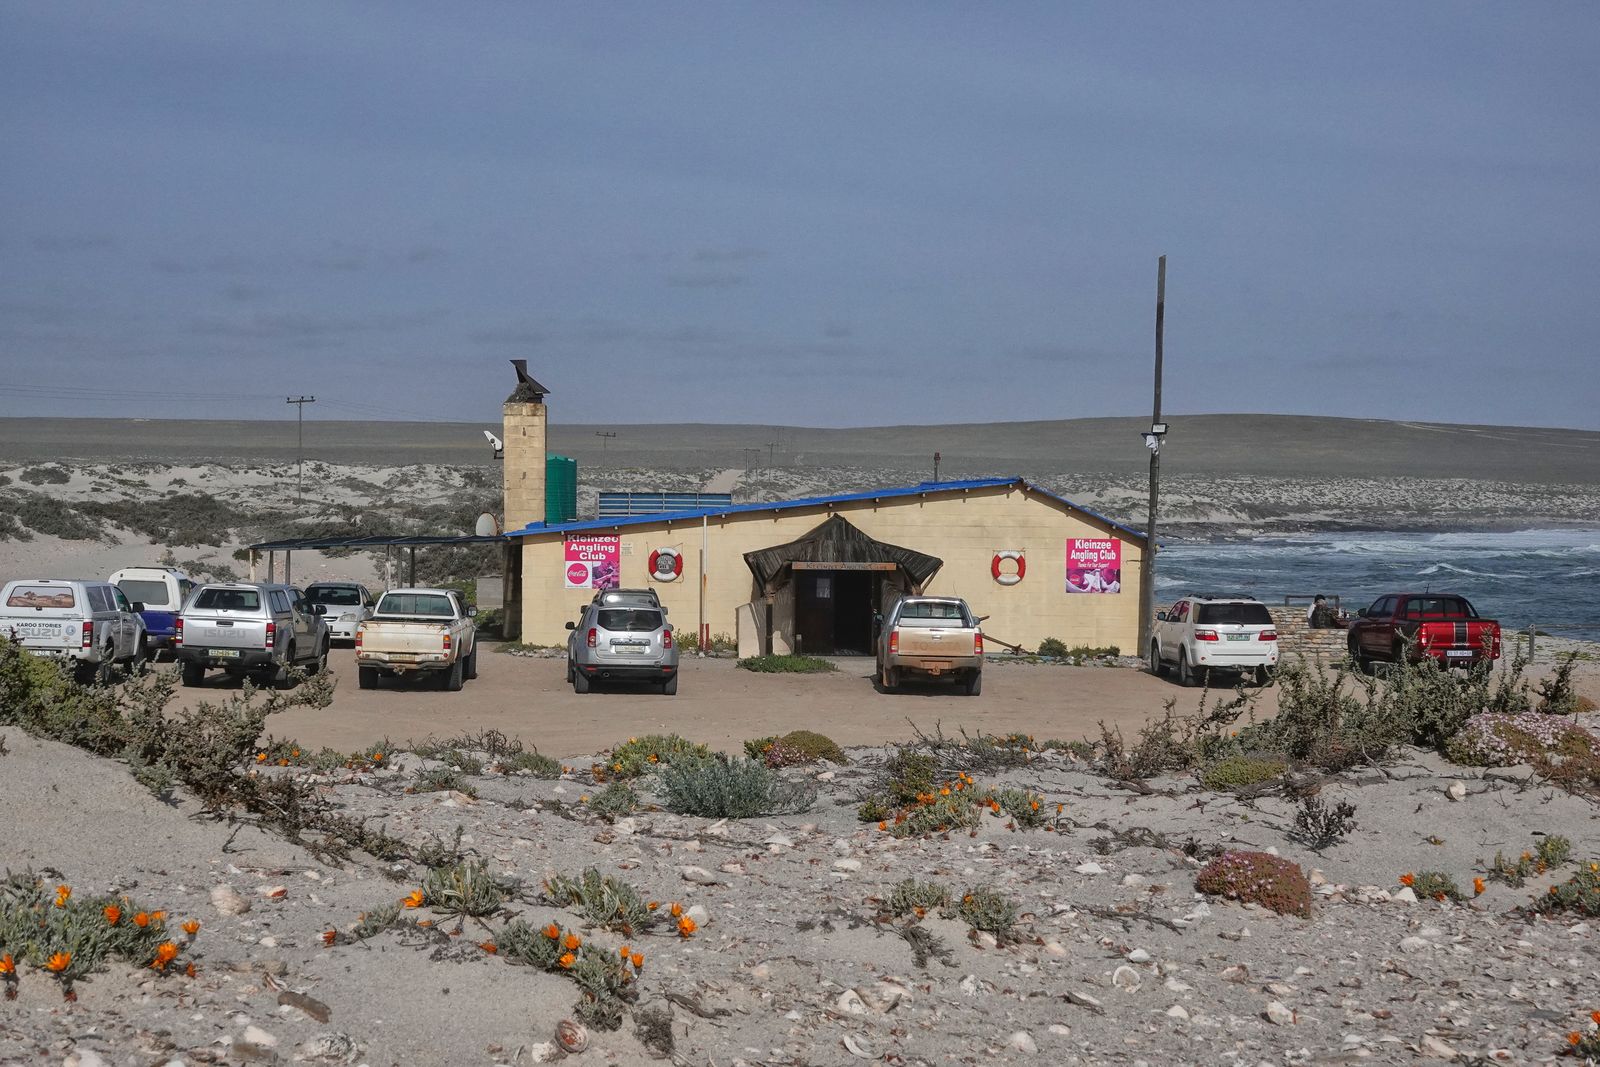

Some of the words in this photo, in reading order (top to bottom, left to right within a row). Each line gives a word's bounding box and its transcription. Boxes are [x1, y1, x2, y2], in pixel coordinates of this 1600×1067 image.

[570, 543, 615, 553] Angling
[1075, 539, 1112, 550] Kleinzee
[579, 552, 606, 560] Club
[1070, 550, 1098, 562] Angling
[1099, 550, 1116, 560] Club
[17, 628, 62, 637] ISUZU
[204, 628, 246, 639] ISUZU
